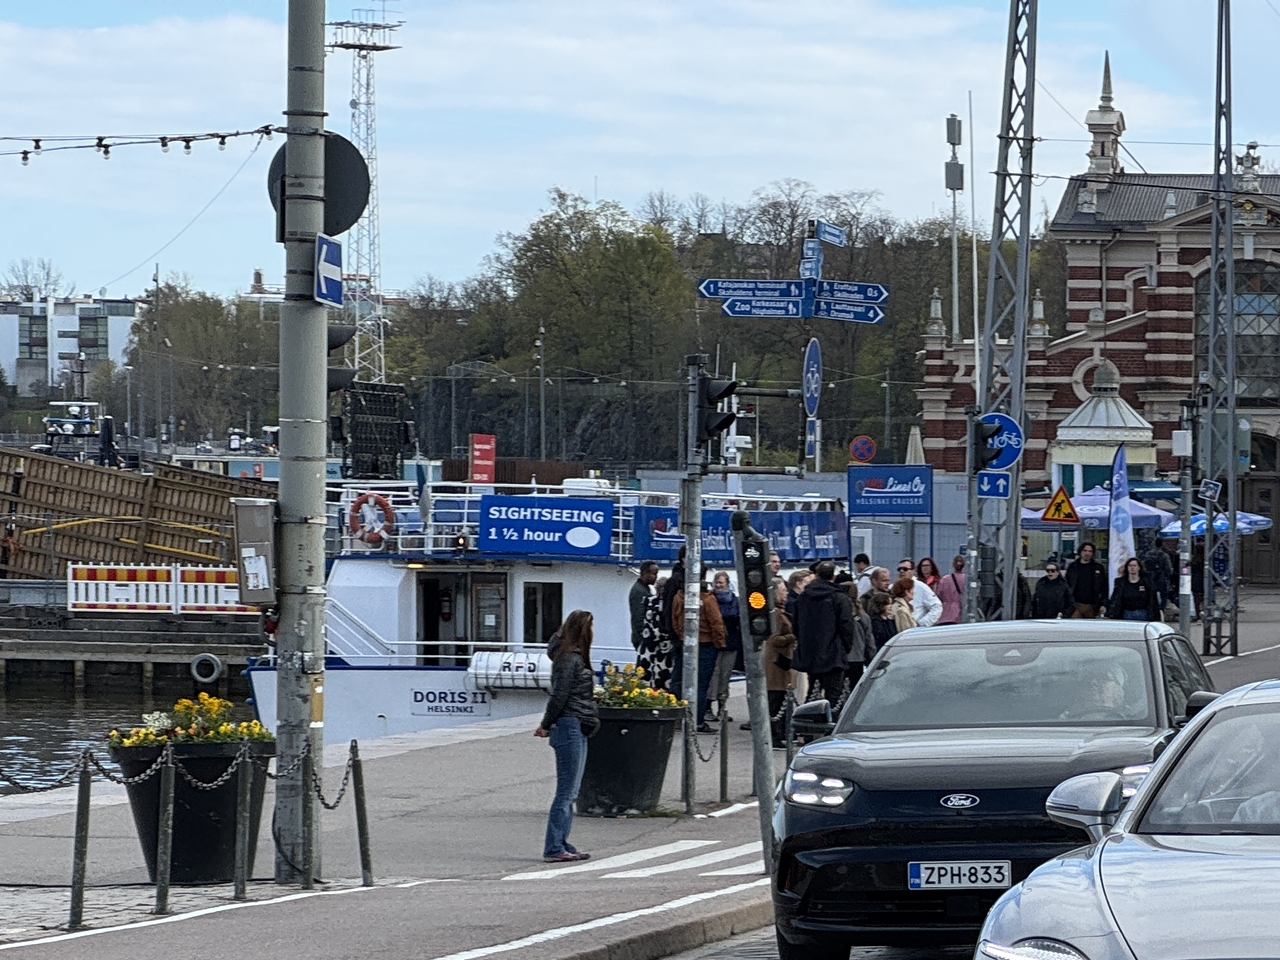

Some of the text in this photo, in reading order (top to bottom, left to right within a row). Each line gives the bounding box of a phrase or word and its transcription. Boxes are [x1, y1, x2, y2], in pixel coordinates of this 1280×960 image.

[709, 284, 714, 292] 1
[734, 302, 750, 312] Zoo
[867, 309, 875, 318] 4
[488, 506, 604, 523] SIGHTSEEING
[488, 527, 498, 539] 1
[523, 529, 563, 542] hour
[502, 661, 537, 672] RFD
[413, 691, 488, 704] DORIS II
[427, 705, 475, 714] HELSINKI
[947, 795, 972, 806] Ford
